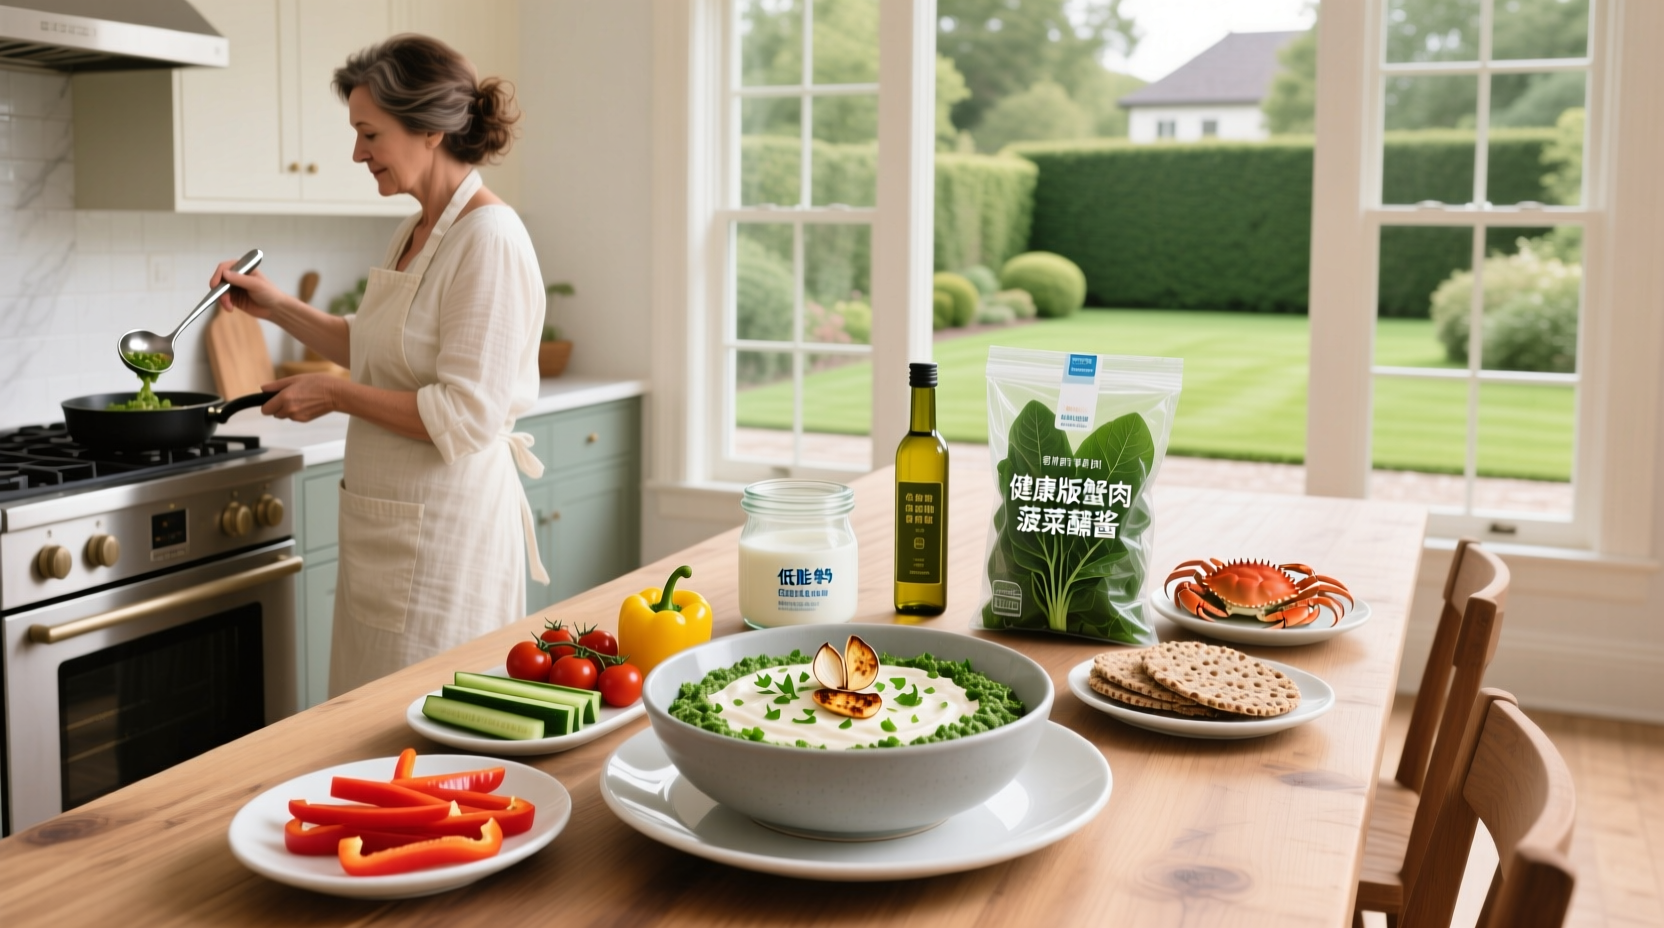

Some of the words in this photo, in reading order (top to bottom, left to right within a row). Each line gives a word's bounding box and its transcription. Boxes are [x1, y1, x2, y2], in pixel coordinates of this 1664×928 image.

[1010, 473, 1132, 508] 健康版蟹肉
